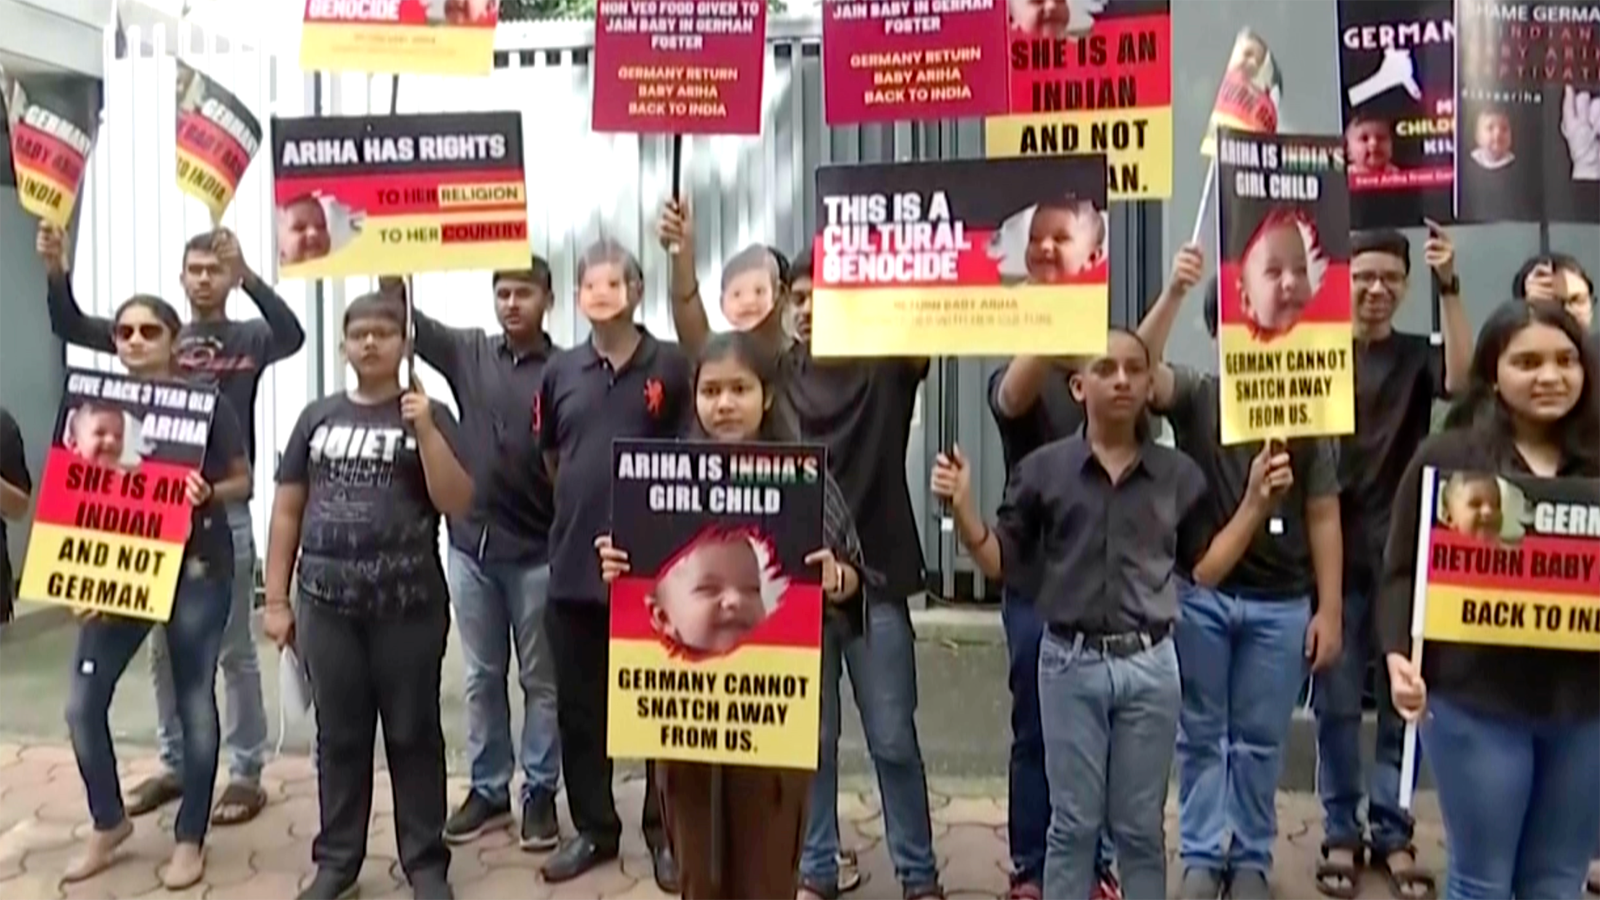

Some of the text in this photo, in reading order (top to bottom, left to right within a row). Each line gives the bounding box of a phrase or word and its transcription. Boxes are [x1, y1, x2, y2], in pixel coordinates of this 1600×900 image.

[308, 0, 400, 20] GENOCIDE
[600, 1, 628, 15] NON
[660, 1, 694, 15] FOOD
[697, 1, 738, 15] GIVEN
[742, 1, 759, 15] TO
[833, 0, 994, 20] JAIN BABY IN GERMAN
[1466, 3, 1528, 22] HAME
[605, 18, 753, 33] JAIN BABY IN GERMAN
[885, 17, 941, 35] FOSTER
[651, 35, 703, 50] FOSTER
[850, 46, 981, 68] GERMANY RETURN
[1011, 31, 1157, 71] SHE IS AN
[618, 66, 738, 81] GERMANY RETURN
[874, 67, 962, 85] BABY ARIHA
[638, 84, 718, 98] BABY ARIHA
[864, 85, 972, 105] BACK TO INDIA
[1032, 75, 1137, 113] INDIAN
[628, 102, 727, 117] BACK TO INDIA
[283, 133, 506, 166] ARIHA HAS RIGHTS
[1020, 118, 1148, 153] AND NOT
[1220, 138, 1345, 173] ARIHA IS INDIA'S
[23, 174, 63, 208] INDIA
[187, 165, 226, 202] INDIA
[377, 186, 519, 206] TO HER RELIGION
[1235, 171, 1319, 200] GIRL CHILD
[823, 190, 950, 225] THIS IS A
[379, 222, 524, 244] TO HER COUNTRY
[823, 221, 972, 254] CULTURAL
[823, 249, 959, 283] GENOCIDE
[1226, 349, 1347, 375] GERMANY CANNOT
[68, 373, 216, 413] GIVE BACK 3 YEAR OLD
[1236, 375, 1332, 402] SNATCH AWAY
[141, 413, 208, 446] ARIHA
[1249, 402, 1311, 429] FROM US.
[619, 453, 818, 483] ARIHA IS INDIA'S
[66, 463, 187, 506] SHE IS AN
[650, 486, 780, 514] GIRL CHILD
[75, 501, 163, 539] INDIAN
[58, 537, 167, 577] AND NOT
[1432, 543, 1596, 582] RETURN BABY
[47, 572, 155, 614] GERMAN.
[1462, 598, 1526, 629] BACK
[1532, 604, 1562, 631] TO
[618, 668, 809, 699] GERMANY CANNOT
[637, 696, 788, 726] SNATCH AWAY
[660, 726, 758, 754] FROM US.
